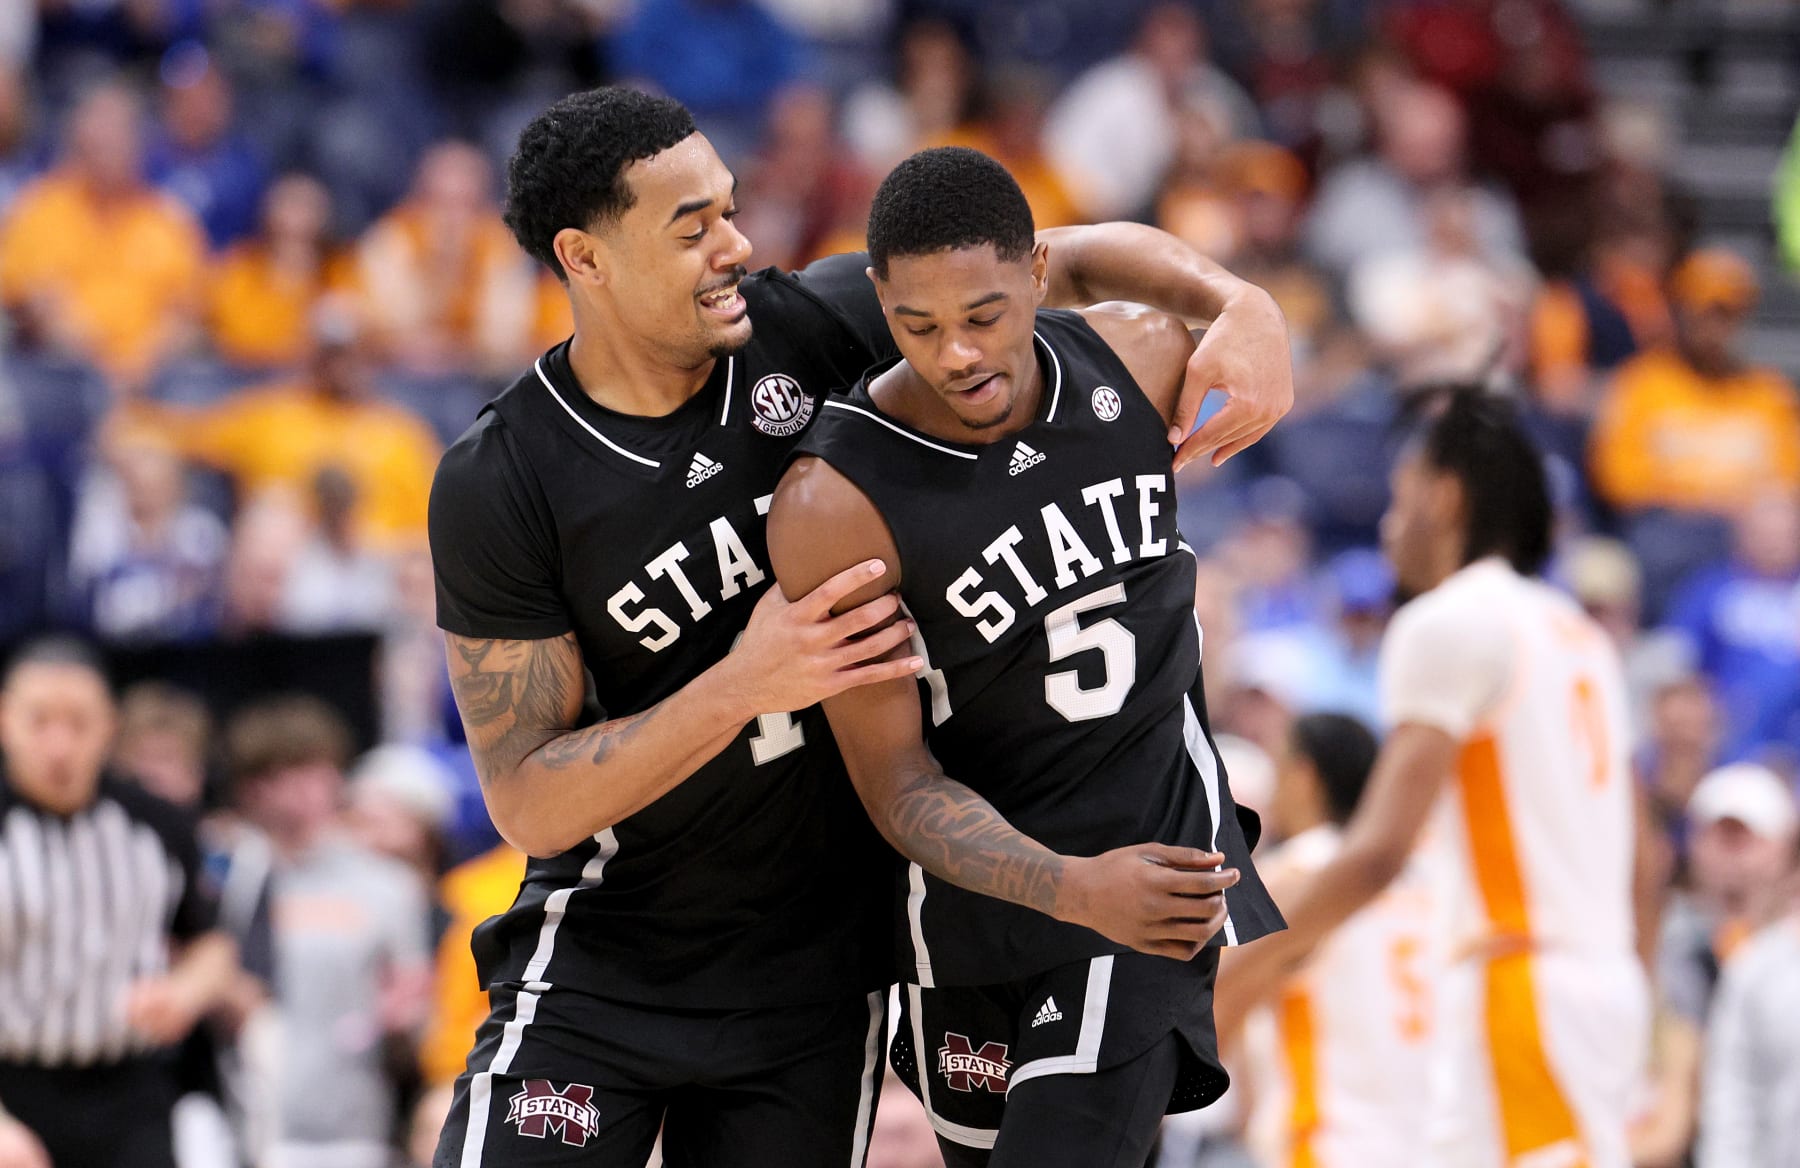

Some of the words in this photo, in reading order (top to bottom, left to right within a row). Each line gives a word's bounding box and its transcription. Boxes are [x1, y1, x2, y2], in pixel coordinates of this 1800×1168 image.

[756, 378, 799, 421] SEC
[1094, 388, 1119, 419] SEC
[763, 408, 812, 436] GRADUATE
[686, 462, 724, 489] adidas
[1009, 452, 1047, 476] adidas
[607, 493, 774, 653] STA
[946, 474, 1167, 645] STATE
[1044, 581, 1136, 723] 5
[1031, 1011, 1063, 1028] adidas
[951, 1056, 1006, 1079] STATE
[526, 1098, 584, 1124] STATE
